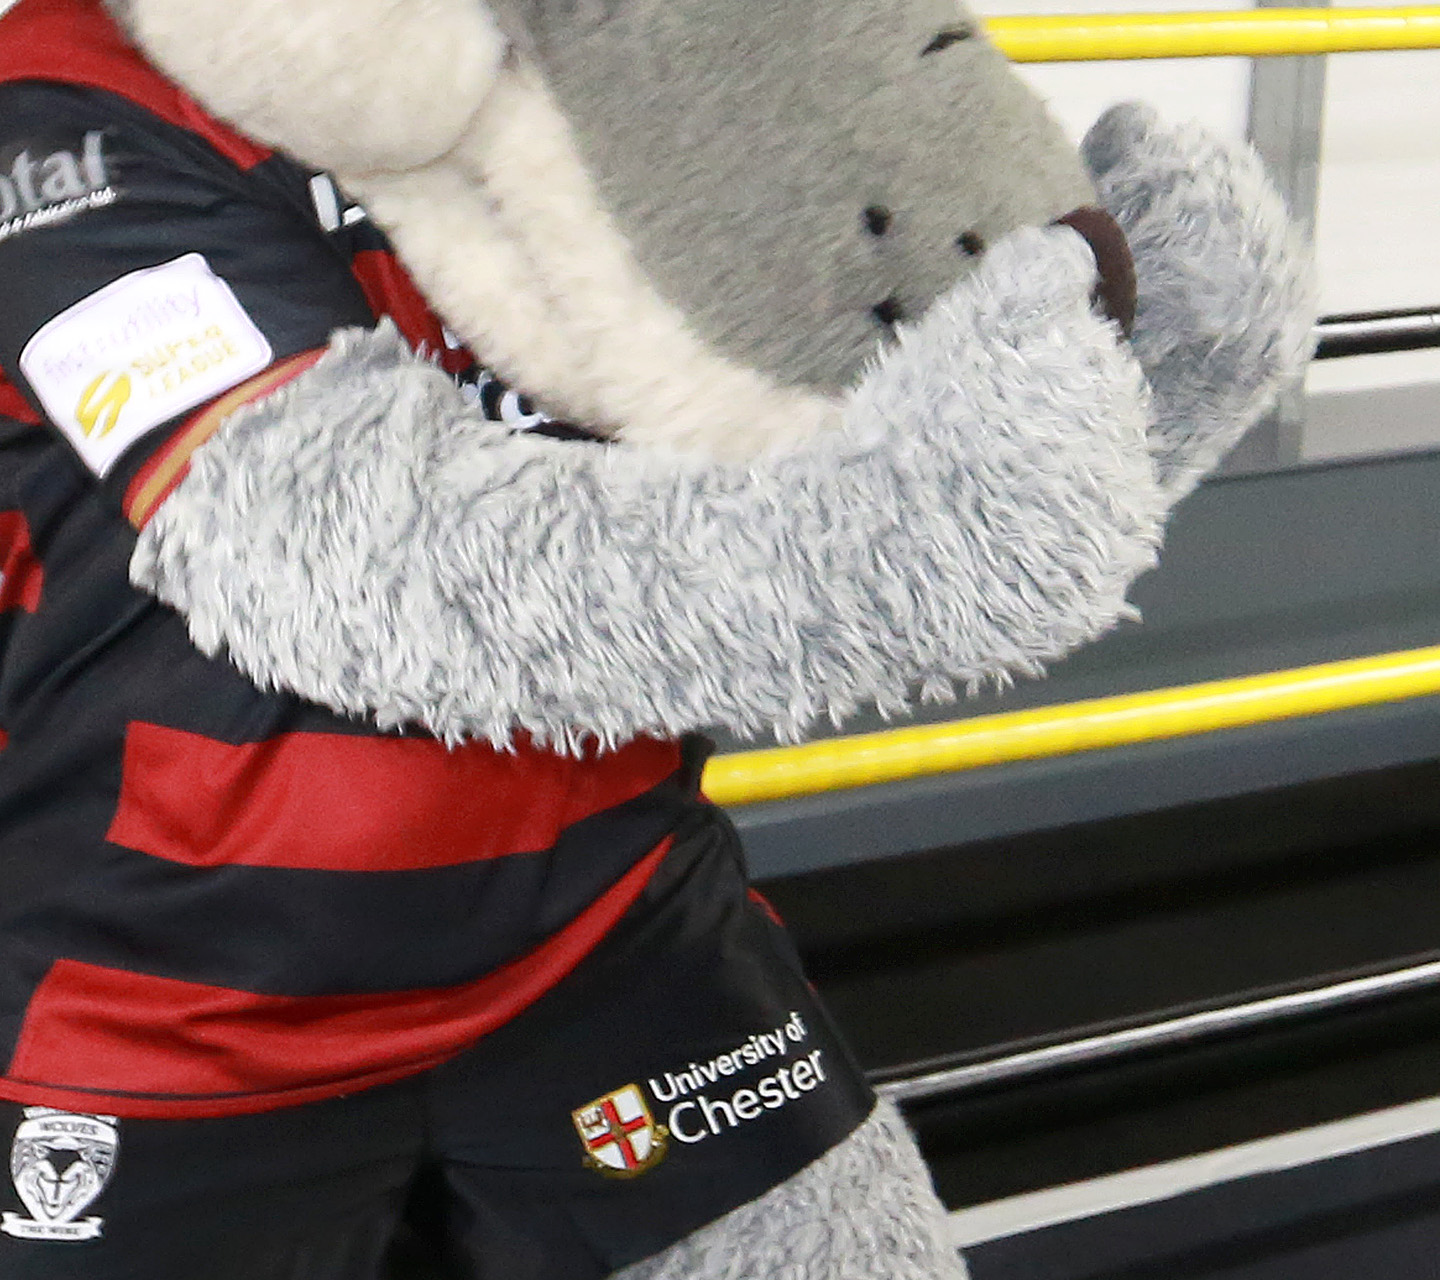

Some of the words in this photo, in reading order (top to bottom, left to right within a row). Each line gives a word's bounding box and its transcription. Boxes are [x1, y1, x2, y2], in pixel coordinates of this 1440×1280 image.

[647, 1027, 787, 1103] University
[785, 1010, 809, 1043] of
[667, 1049, 827, 1144] Chester
